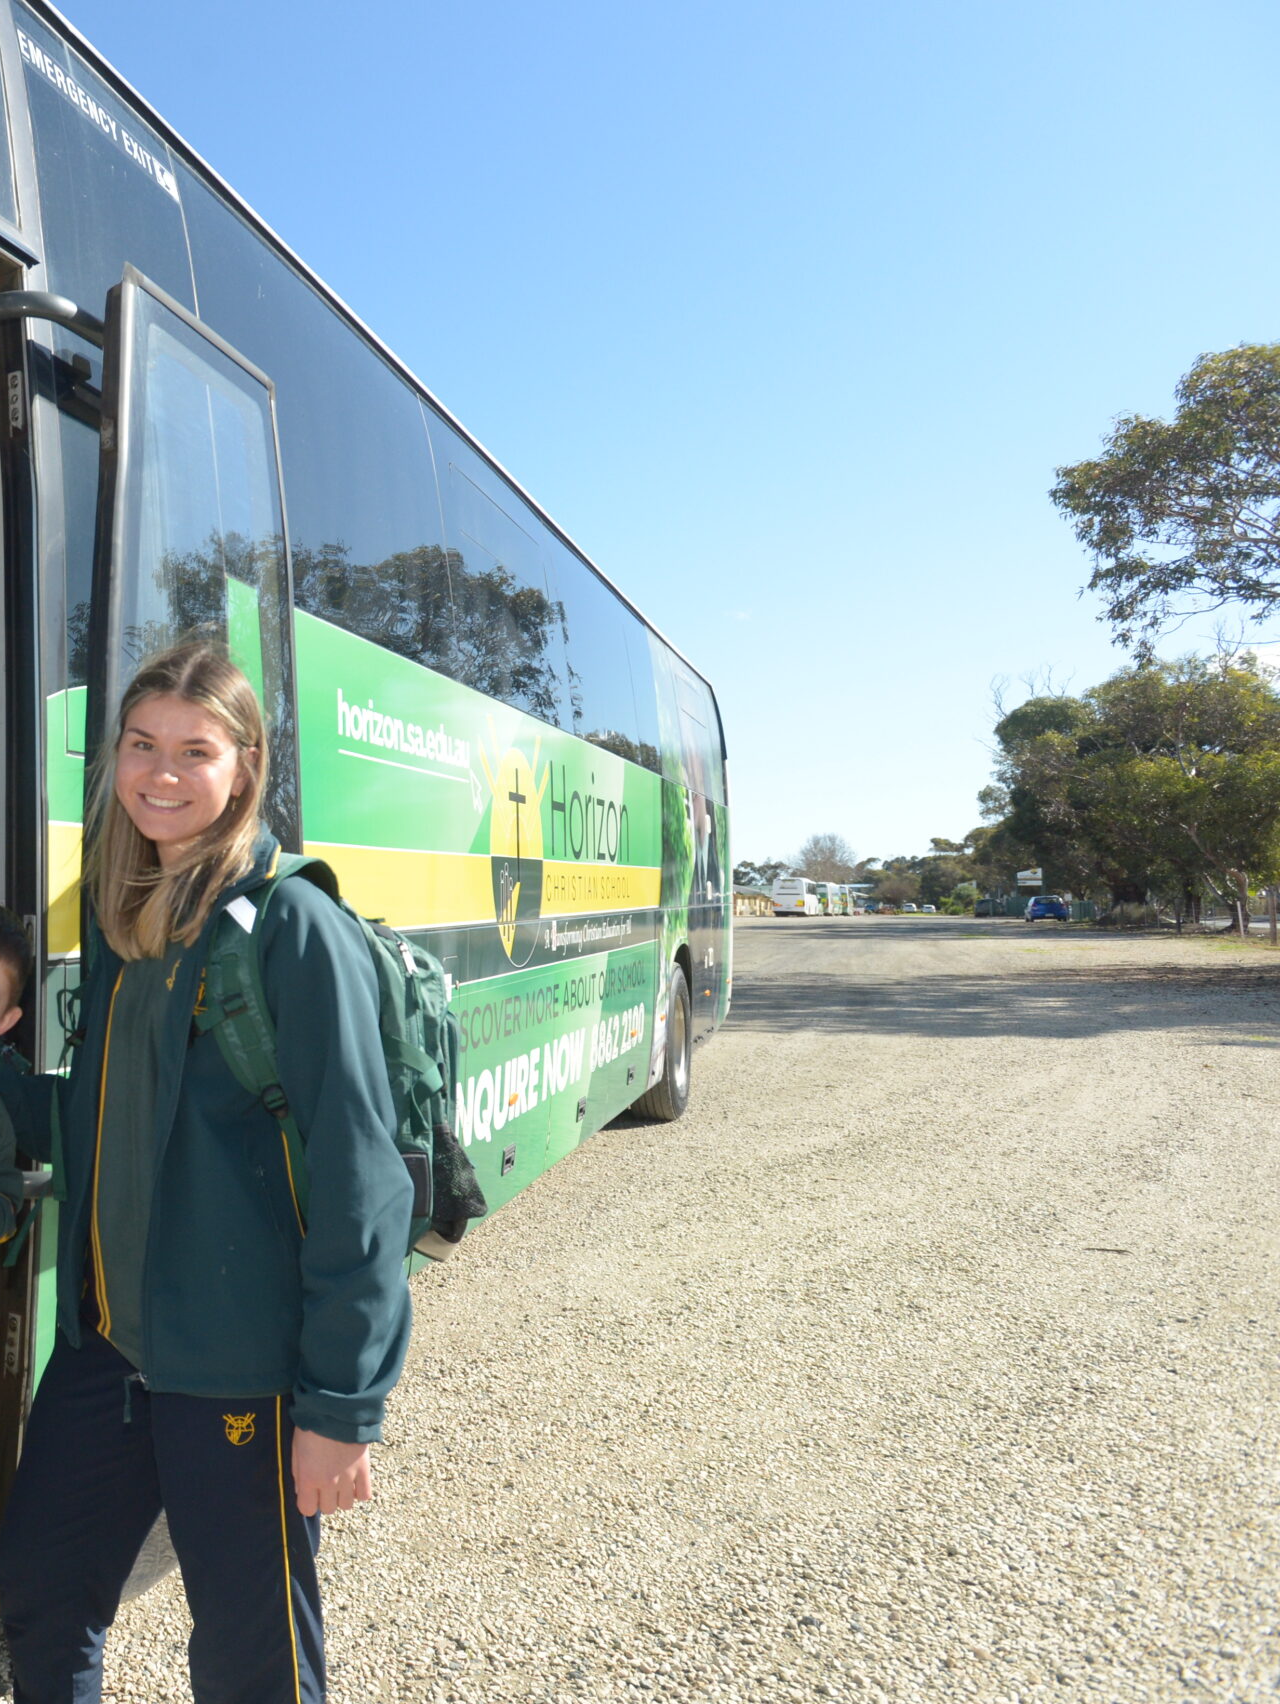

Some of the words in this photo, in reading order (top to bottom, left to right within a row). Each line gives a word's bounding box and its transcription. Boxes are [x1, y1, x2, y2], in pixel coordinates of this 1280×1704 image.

[17, 28, 118, 141] EMERGENCY
[121, 129, 154, 175] EXIT
[337, 687, 471, 769] horizon.sa.edu.au
[550, 760, 629, 862] Horizon
[546, 874, 598, 901] CHRISTIAN
[600, 876, 630, 900] SCHOOL
[460, 996, 521, 1053] SCOVER
[525, 984, 560, 1029] MORE
[563, 976, 597, 1013] ABOUT
[599, 971, 616, 1000] OUR
[618, 960, 646, 994] SCHOOL
[454, 1047, 540, 1147] NQUIRE
[542, 1027, 586, 1102] NOW
[590, 1014, 619, 1073] 8862
[621, 1002, 645, 1055] 2100
